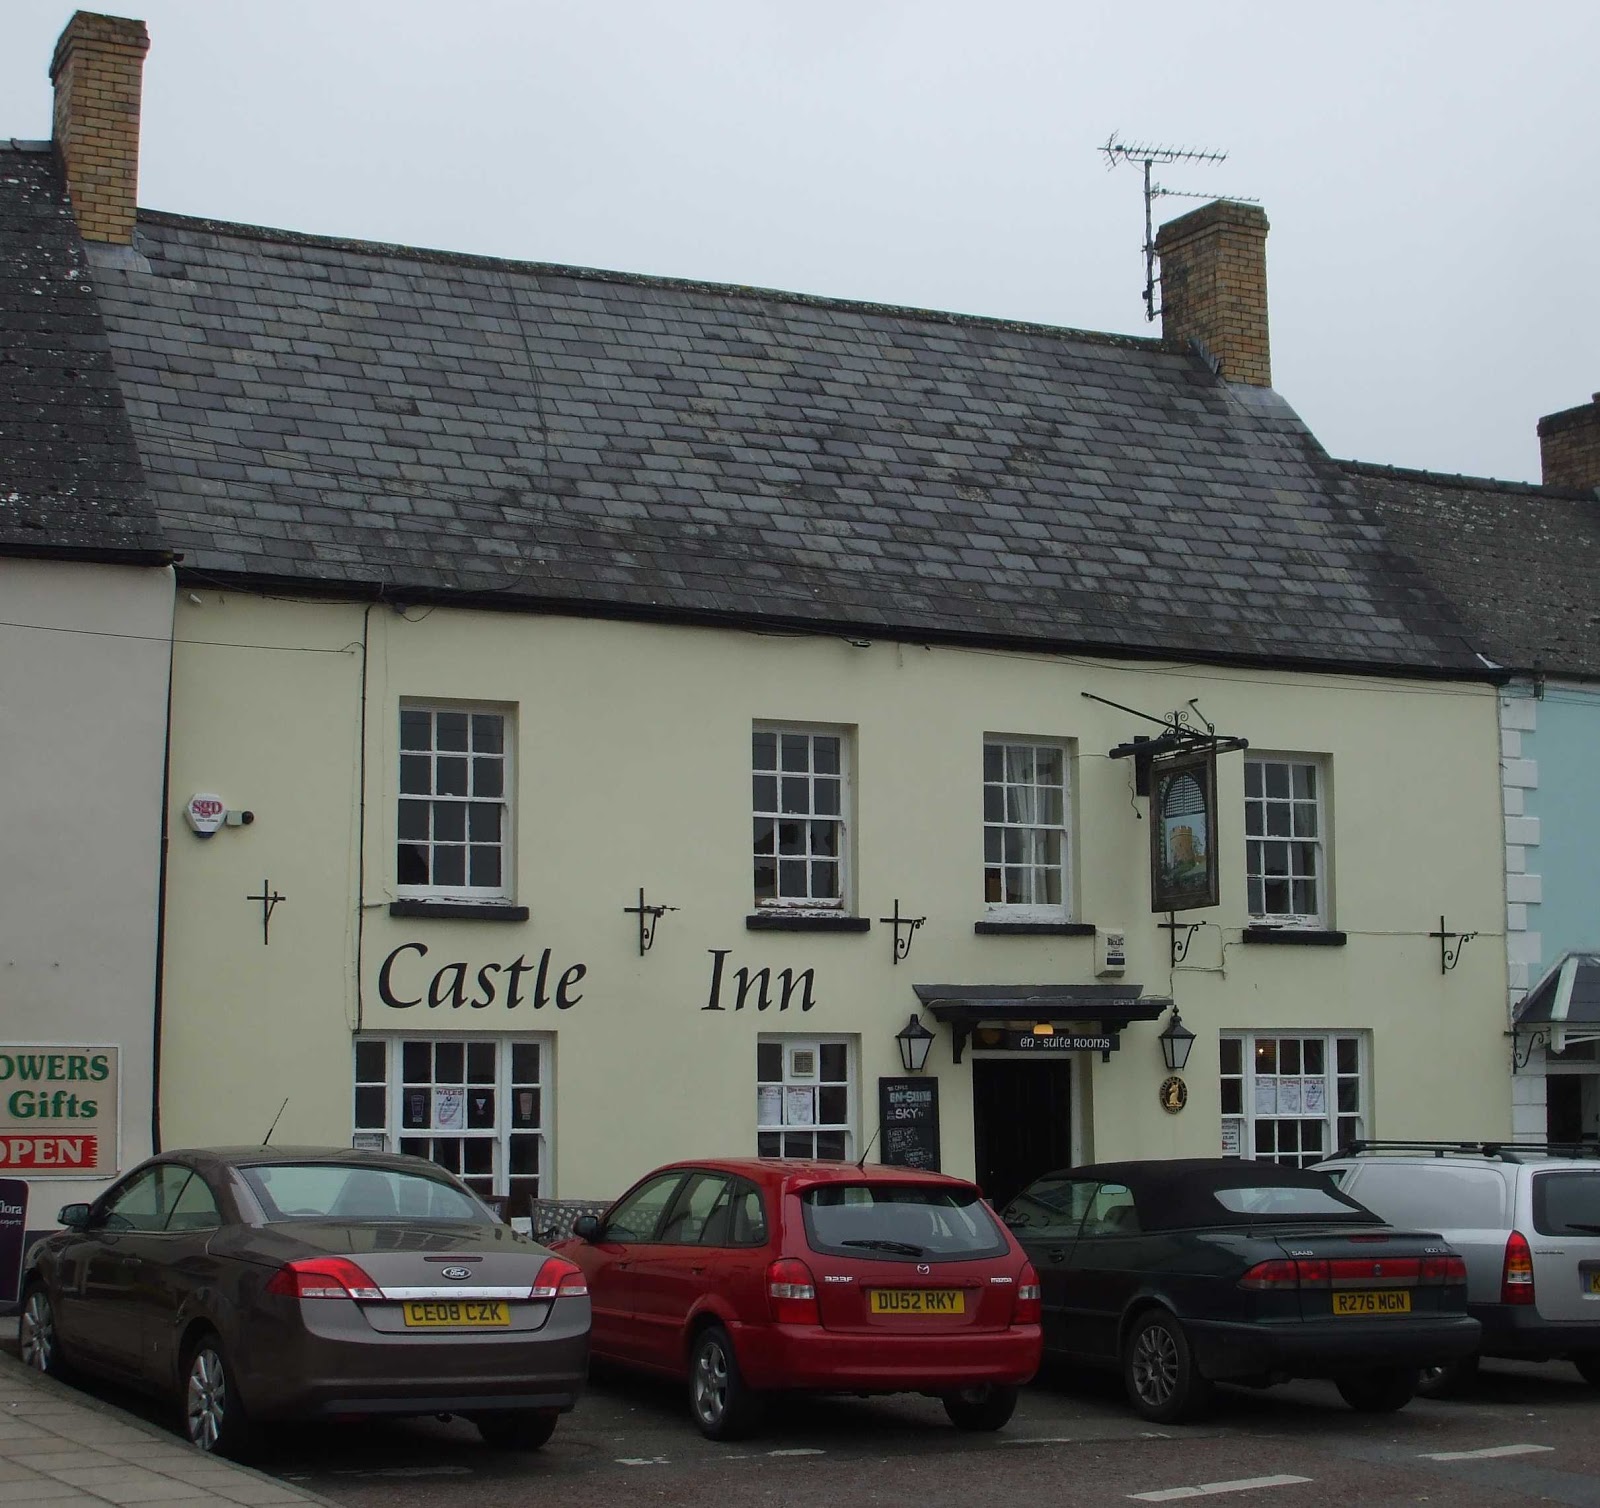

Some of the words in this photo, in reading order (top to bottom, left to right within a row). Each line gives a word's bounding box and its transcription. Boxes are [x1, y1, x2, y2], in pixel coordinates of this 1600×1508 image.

[378, 942, 587, 1010] Castle
[700, 949, 817, 1012] Inn
[8, 1090, 98, 1119] Gifts
[895, 1107, 919, 1120] SKY
[878, 1292, 922, 1309] DU52
[925, 1291, 957, 1309] RKY
[1338, 1294, 1375, 1311] R276
[1378, 1292, 1406, 1309] MGN
[411, 1303, 461, 1321] CE08
[466, 1303, 502, 1321] CZK
